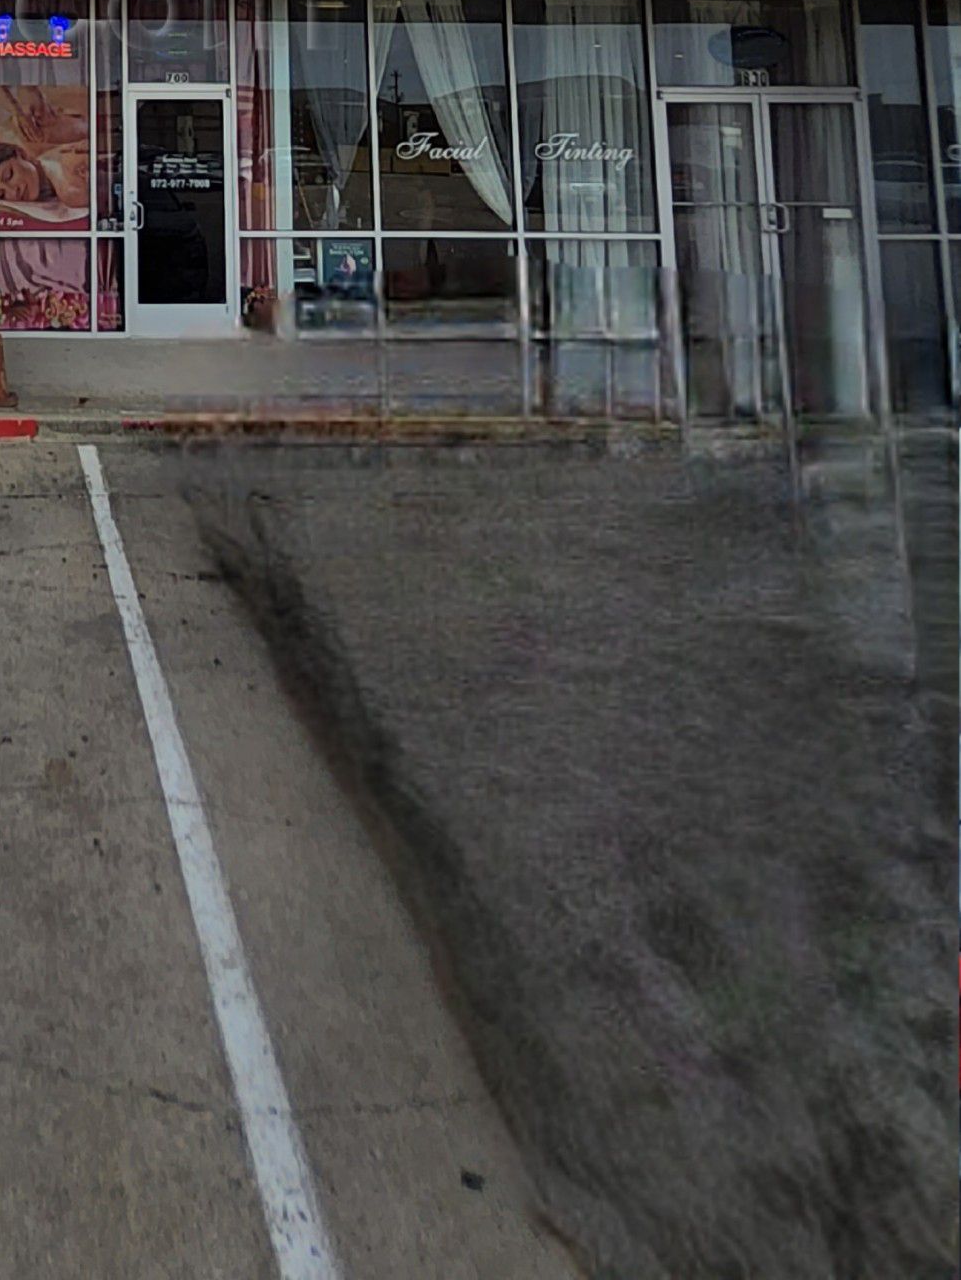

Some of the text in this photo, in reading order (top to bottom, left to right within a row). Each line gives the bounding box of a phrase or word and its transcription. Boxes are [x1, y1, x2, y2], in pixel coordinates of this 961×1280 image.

[396, 132, 488, 160] Facial
[534, 132, 636, 170] Tinting
[6, 218, 24, 226] Spa
